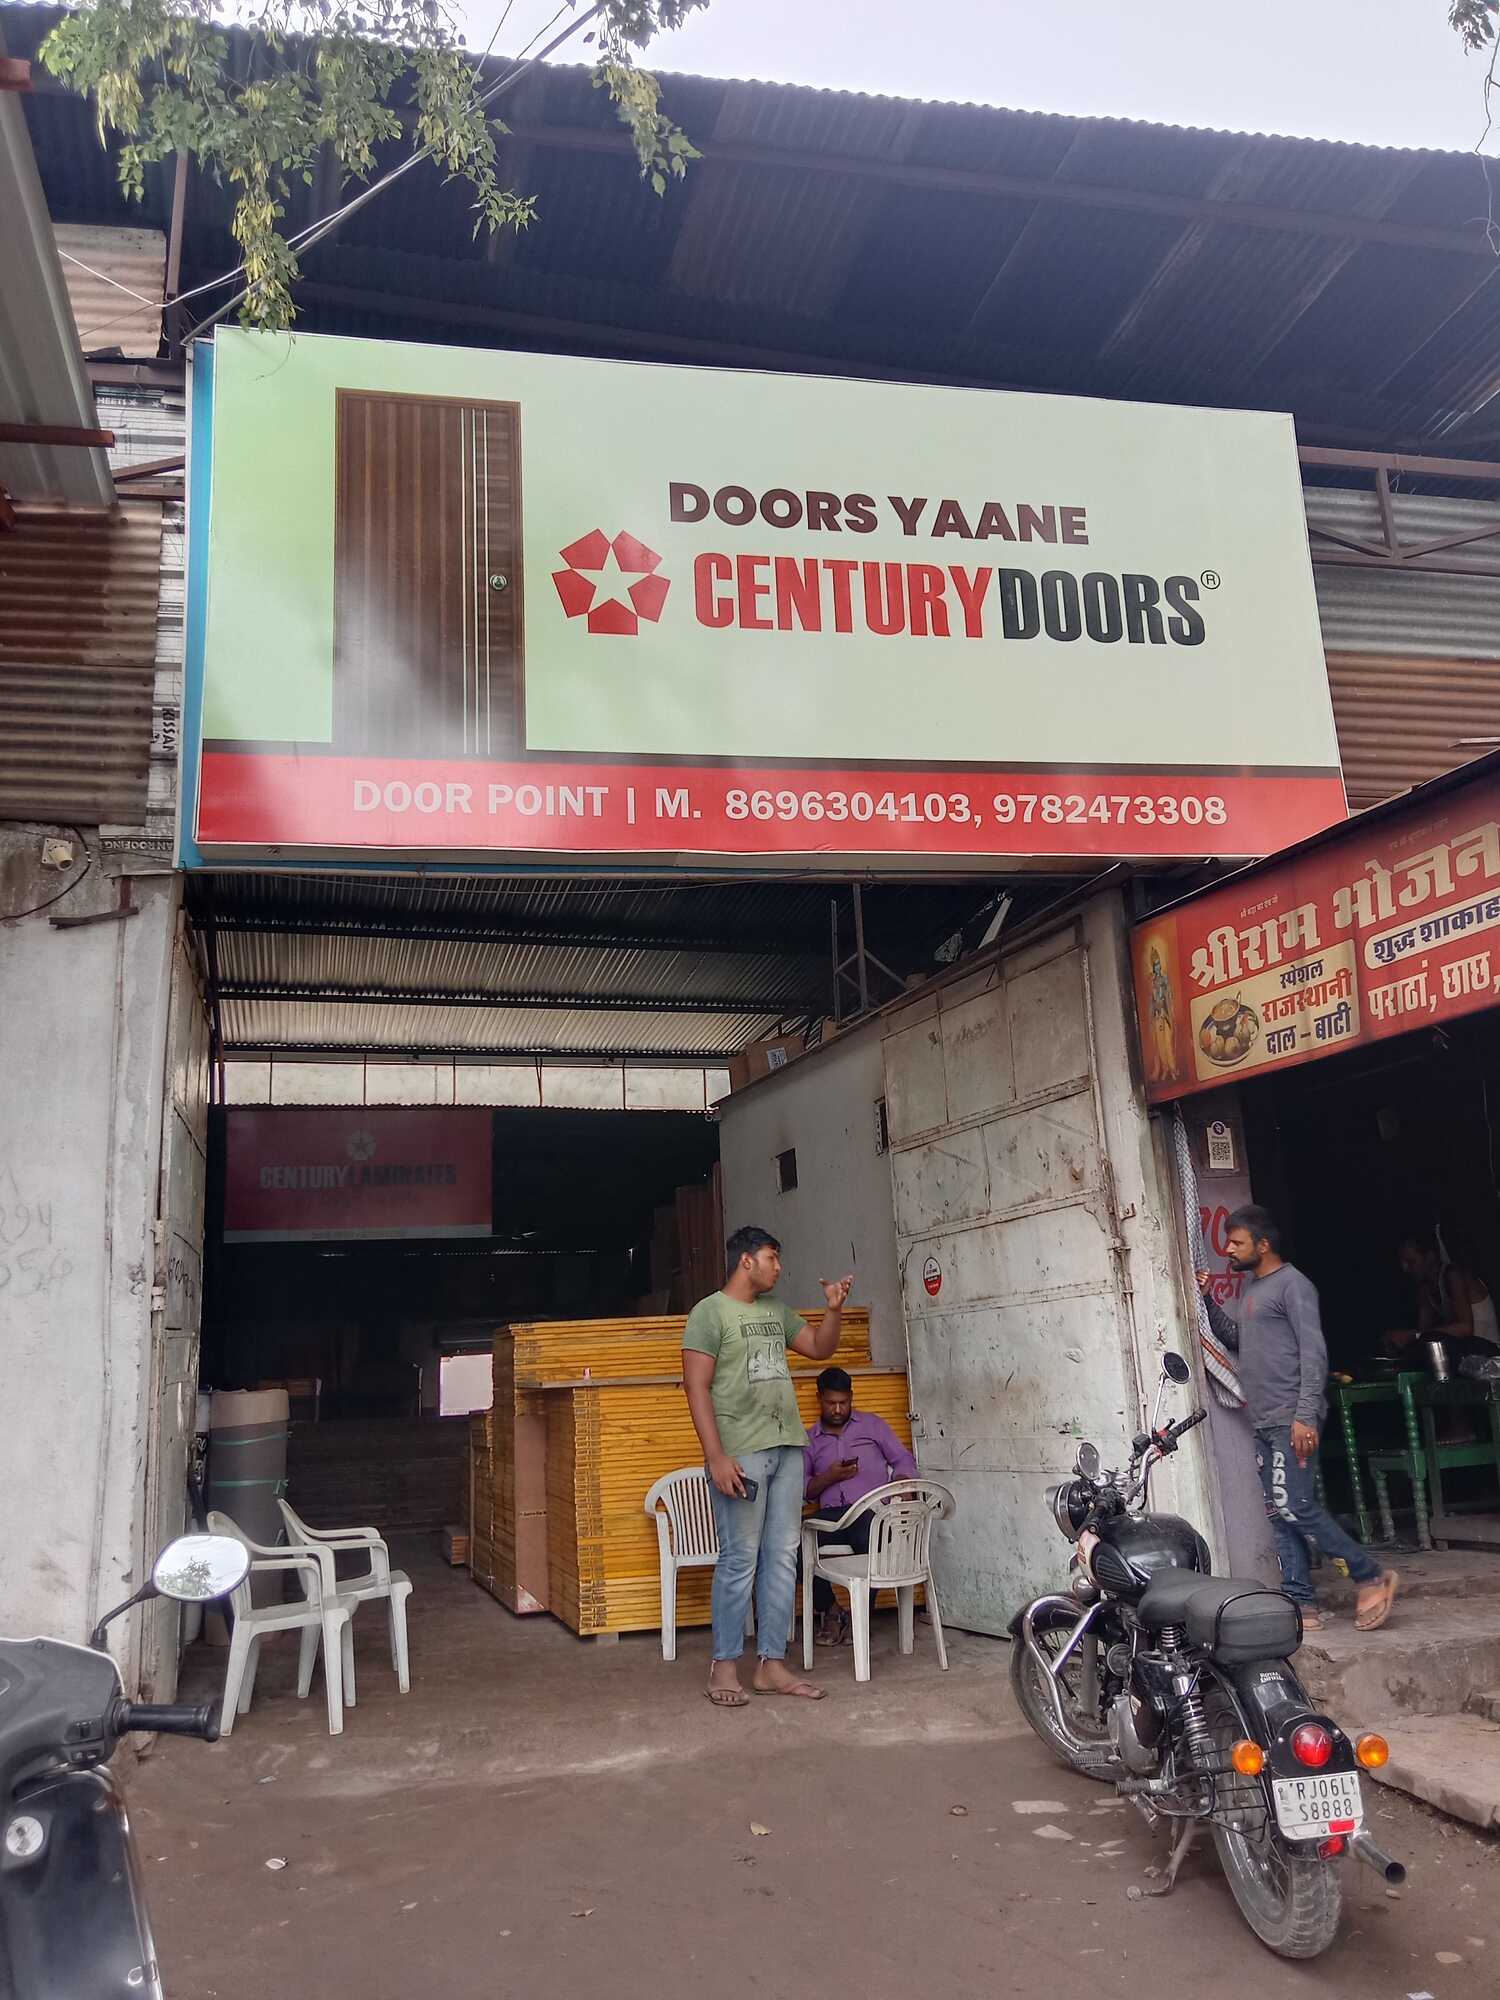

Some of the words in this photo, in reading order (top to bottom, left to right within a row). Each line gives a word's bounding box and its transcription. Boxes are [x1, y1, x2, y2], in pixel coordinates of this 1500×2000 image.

[669, 482, 878, 534] DOORS
[887, 495, 1089, 545] YAANE
[353, 780, 473, 814] DOOR
[488, 784, 609, 817] POINT
[655, 788, 702, 818] M.
[725, 788, 982, 829] 8696304103,
[993, 793, 1228, 826] 9782473308
[104, 840, 155, 850] ROOFING
[1188, 902, 1321, 989] श्रीराम
[1373, 927, 1417, 963] शुद्ध
[1261, 967, 1353, 1023] राजस्थानी
[1279, 958, 1324, 989] स्पेशल
[1265, 1024, 1297, 1055] दाल
[1313, 1001, 1352, 1040] बाटी
[259, 1165, 349, 1190] CENTURY
